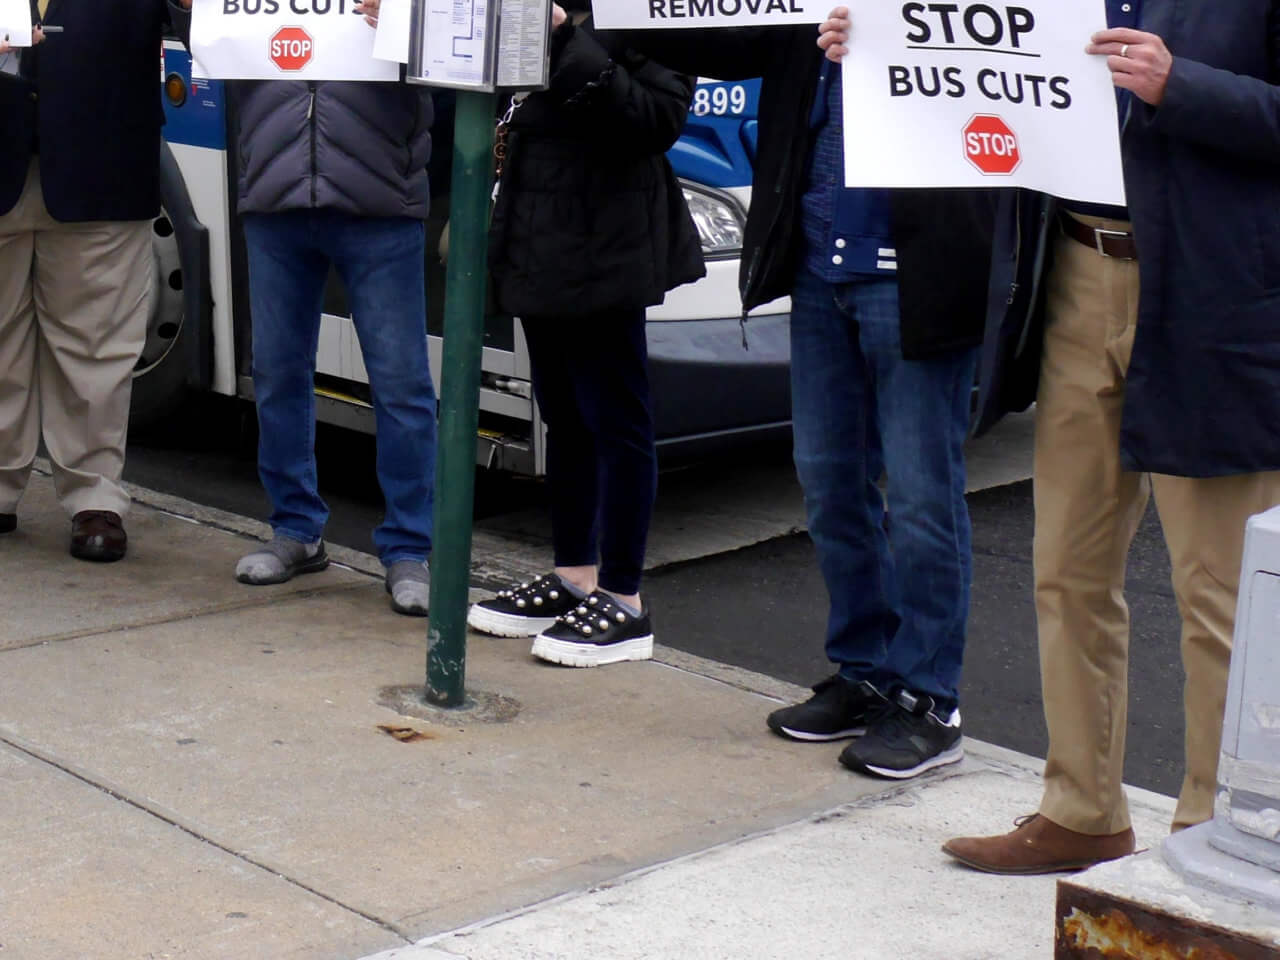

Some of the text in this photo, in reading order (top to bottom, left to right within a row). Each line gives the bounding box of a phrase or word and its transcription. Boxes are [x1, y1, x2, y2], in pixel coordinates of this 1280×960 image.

[902, 2, 1035, 48] STOP
[272, 40, 311, 57] STOP
[689, 85, 746, 116] 899
[888, 65, 1072, 109] BUS CUTS
[967, 132, 1017, 156] STOP
